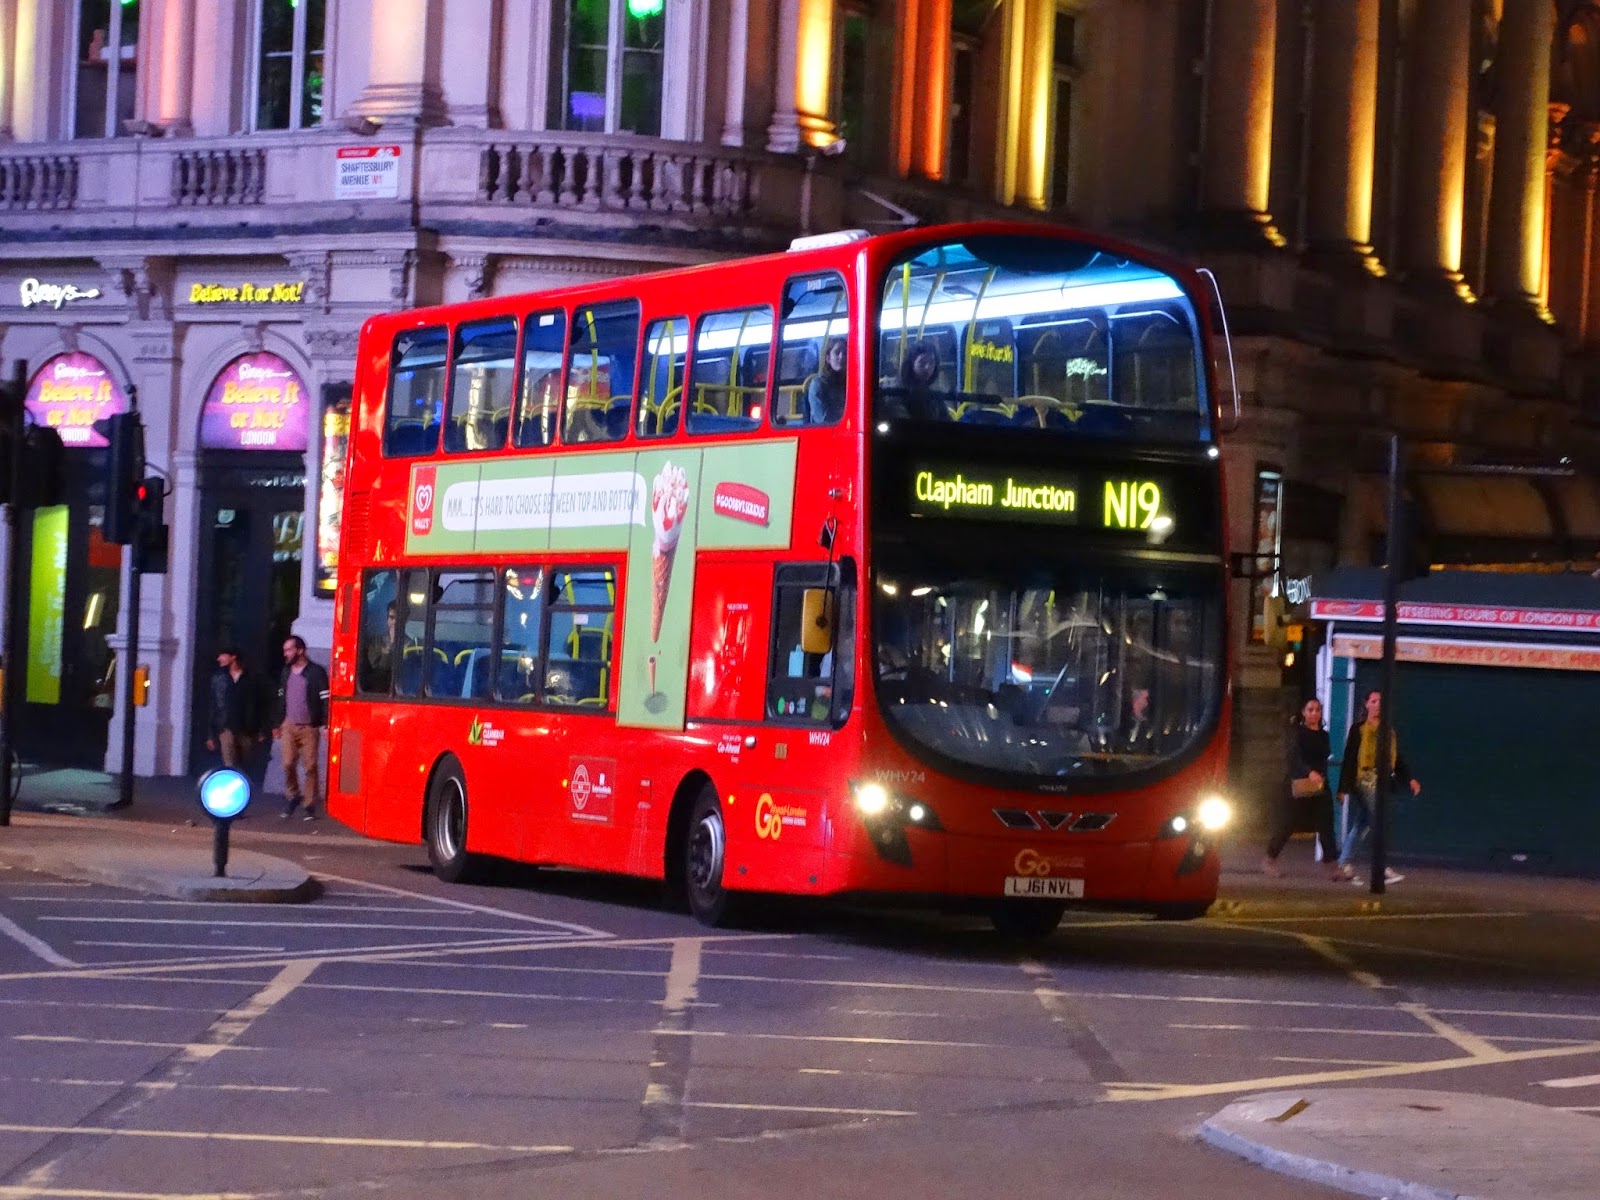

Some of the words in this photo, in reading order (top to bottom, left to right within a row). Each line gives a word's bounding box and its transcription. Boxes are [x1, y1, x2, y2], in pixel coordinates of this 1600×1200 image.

[341, 161, 394, 173] SHAFTESBURY
[341, 175, 369, 186] AVENUE
[189, 283, 239, 302] Believe
[255, 287, 271, 302] or
[241, 430, 277, 445] LONDON
[485, 496, 503, 516] HARD
[505, 495, 514, 515] TO
[515, 493, 543, 515] CHOOSE
[543, 491, 577, 514] BETWEEN
[577, 490, 592, 512] TOP
[592, 489, 608, 512] AND
[609, 488, 640, 512] BOTTOM
[916, 471, 994, 510] Clapham
[1001, 478, 1076, 512] Junction
[1104, 481, 1161, 529] N19
[1456, 608, 1497, 622] TOURS
[1500, 609, 1516, 623] OF
[1519, 611, 1573, 626] LONDON
[874, 768, 926, 783] WHV24
[1014, 848, 1050, 876] Go
[1048, 879, 1075, 896] NVL
